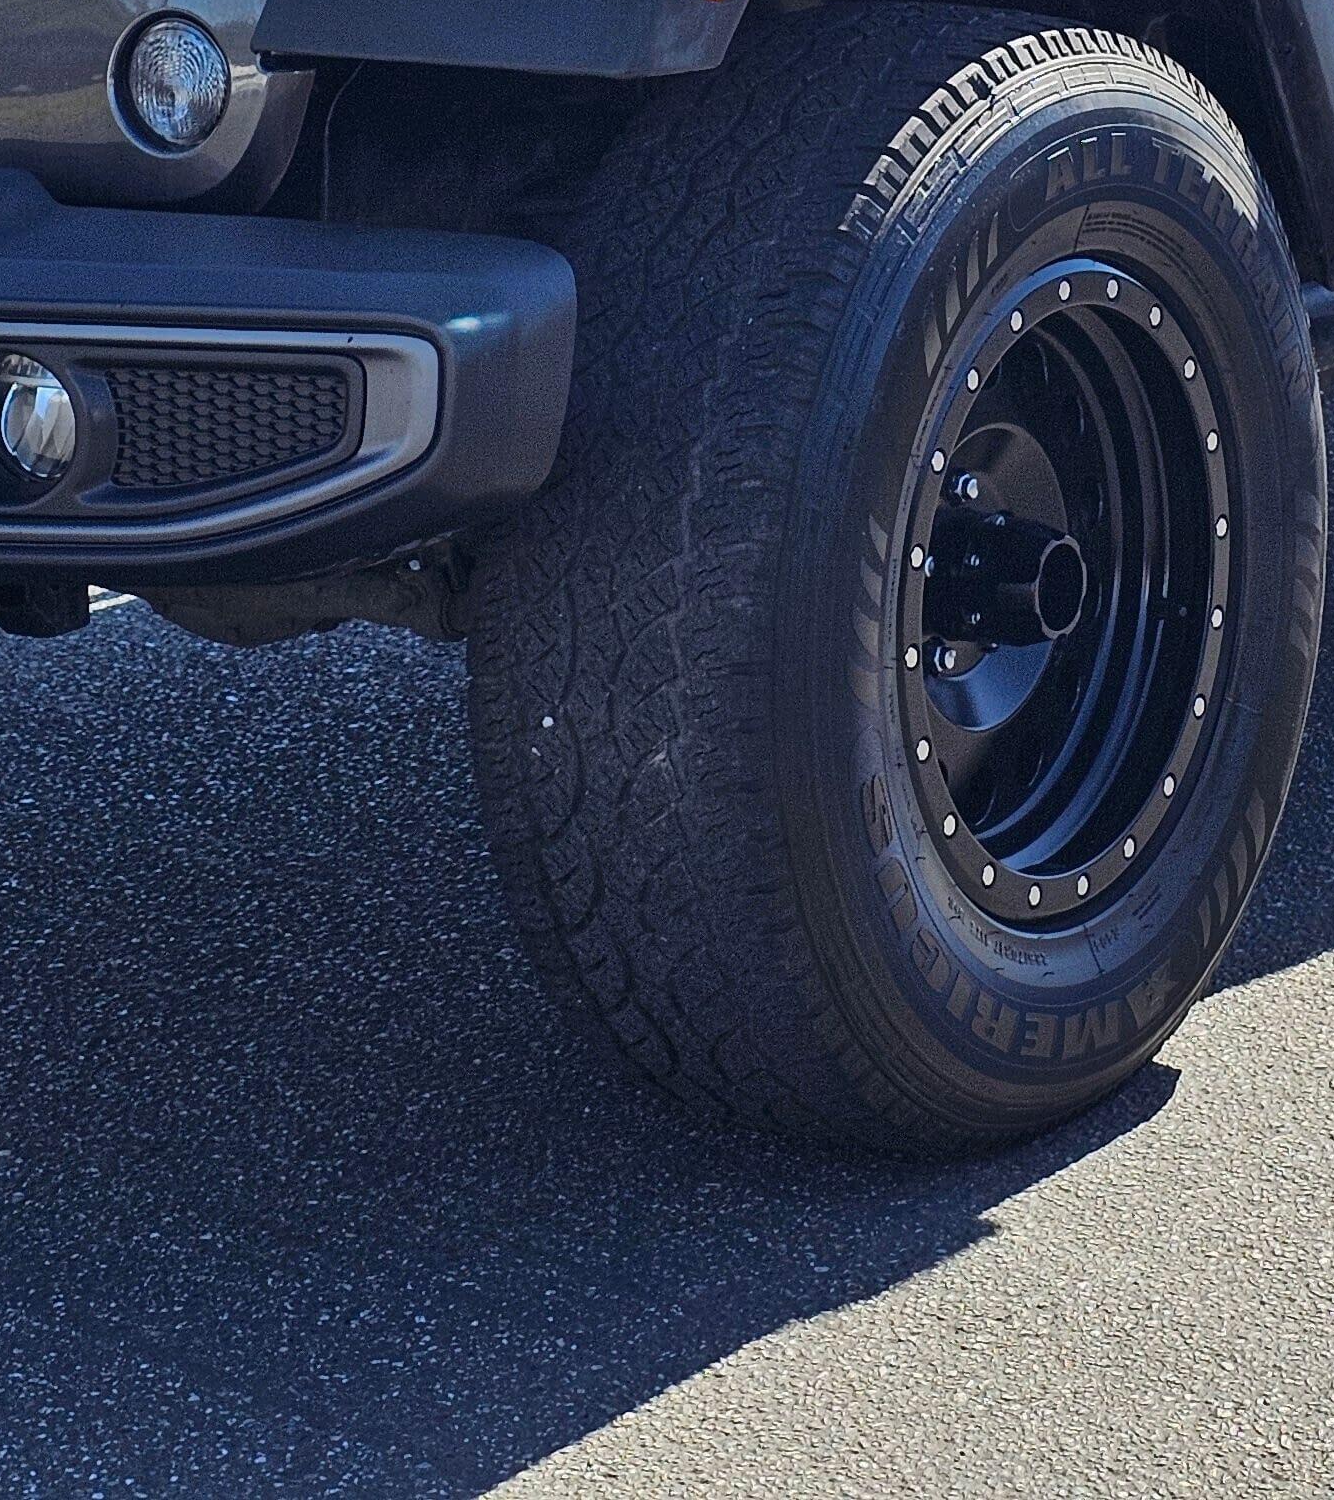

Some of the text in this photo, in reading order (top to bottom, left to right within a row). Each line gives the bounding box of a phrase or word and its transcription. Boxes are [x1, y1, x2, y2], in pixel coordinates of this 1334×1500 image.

[1044, 131, 1133, 202] ALL
[1151, 136, 1310, 407] TERRAIN
[861, 773, 1178, 1061] AMERICUS
